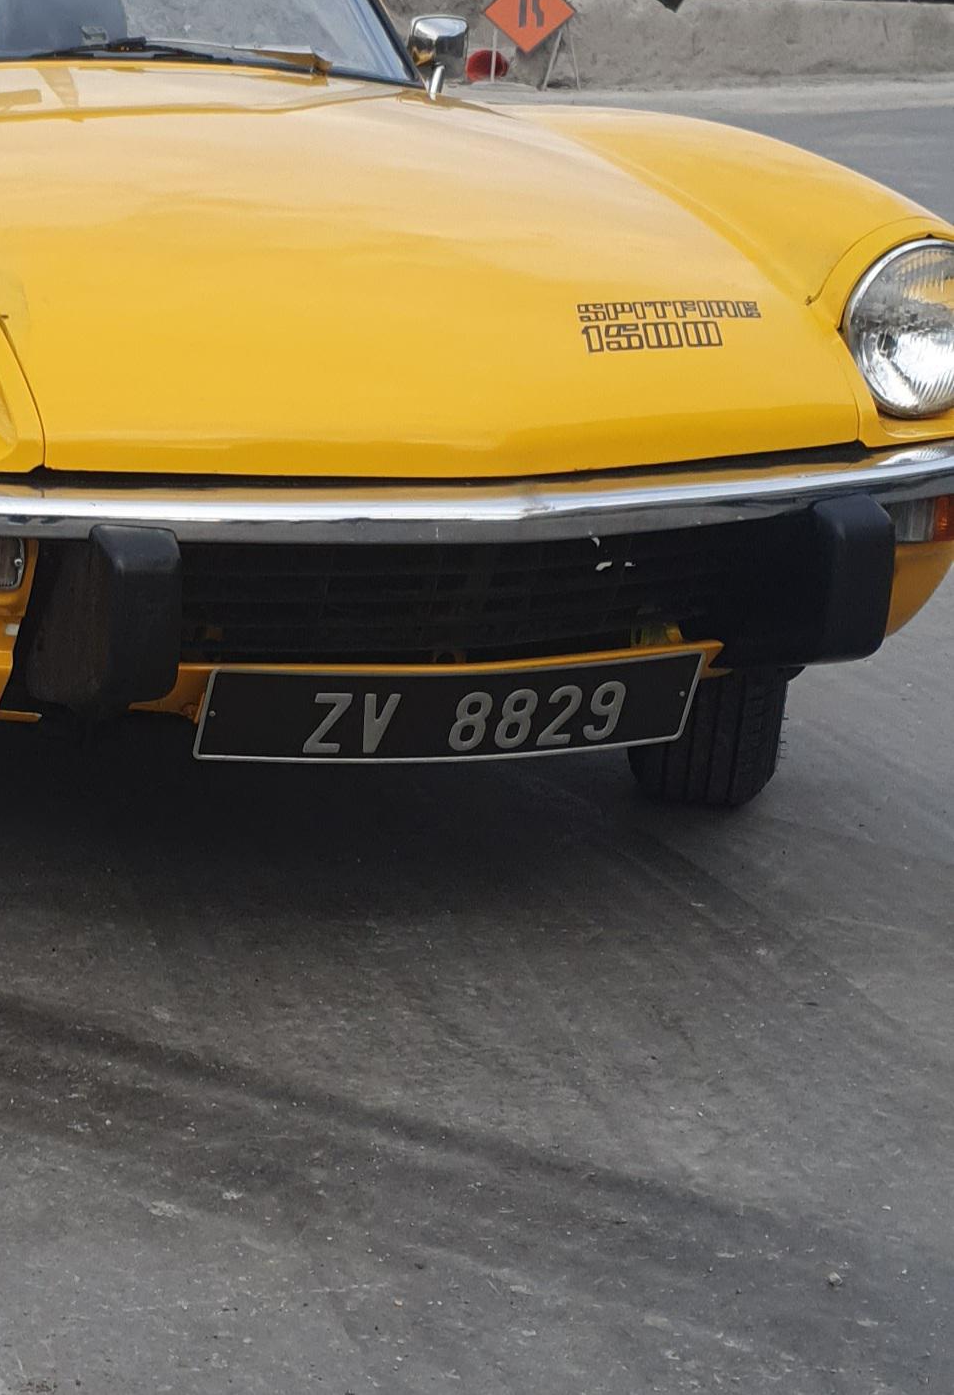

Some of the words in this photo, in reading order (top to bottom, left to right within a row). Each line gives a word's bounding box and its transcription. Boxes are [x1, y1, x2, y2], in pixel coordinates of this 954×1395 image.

[577, 300, 761, 322] SPITFIRE
[581, 321, 723, 353] 1500
[302, 692, 401, 754] ZV
[448, 680, 627, 752] 8829
